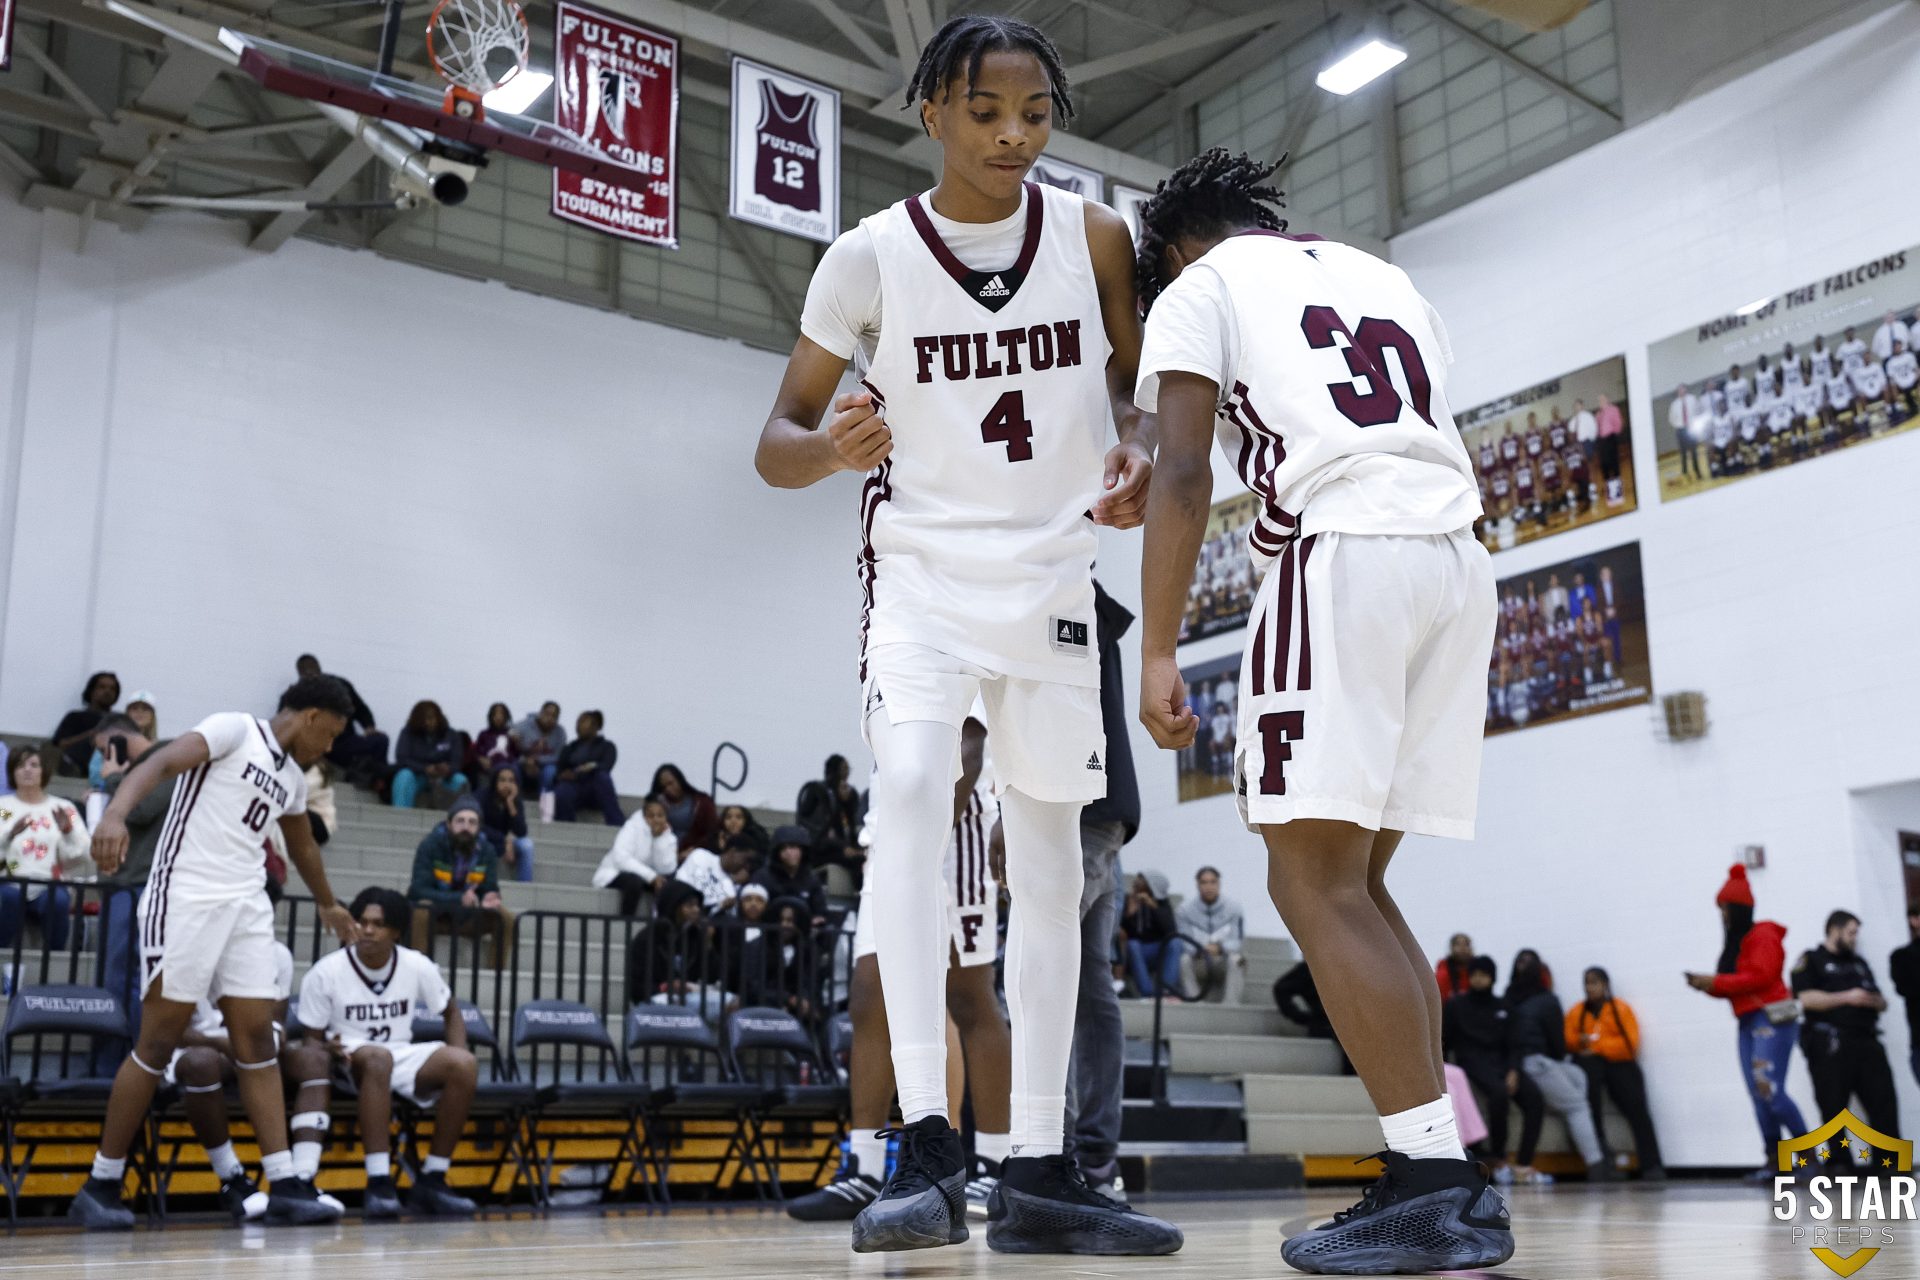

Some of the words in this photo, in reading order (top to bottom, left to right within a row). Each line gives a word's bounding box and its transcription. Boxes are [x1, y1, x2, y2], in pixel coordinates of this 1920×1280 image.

[562, 15, 672, 68] FULTON
[760, 132, 816, 160] FULTON
[581, 178, 645, 209] STATE
[772, 156, 804, 190] 12
[559, 191, 668, 234] TOURNAMENT
[979, 287, 1010, 297] adidas
[1698, 315, 1748, 342] HOME
[1784, 283, 1818, 310] THE
[1824, 251, 1907, 296] FALCONS
[913, 319, 1082, 384] FULTON
[1300, 304, 1437, 429] 30
[980, 390, 1034, 463] 4
[1258, 710, 1305, 796] F
[242, 796, 270, 833] 10
[961, 914, 983, 953] F
[345, 999, 409, 1021] FULTON
